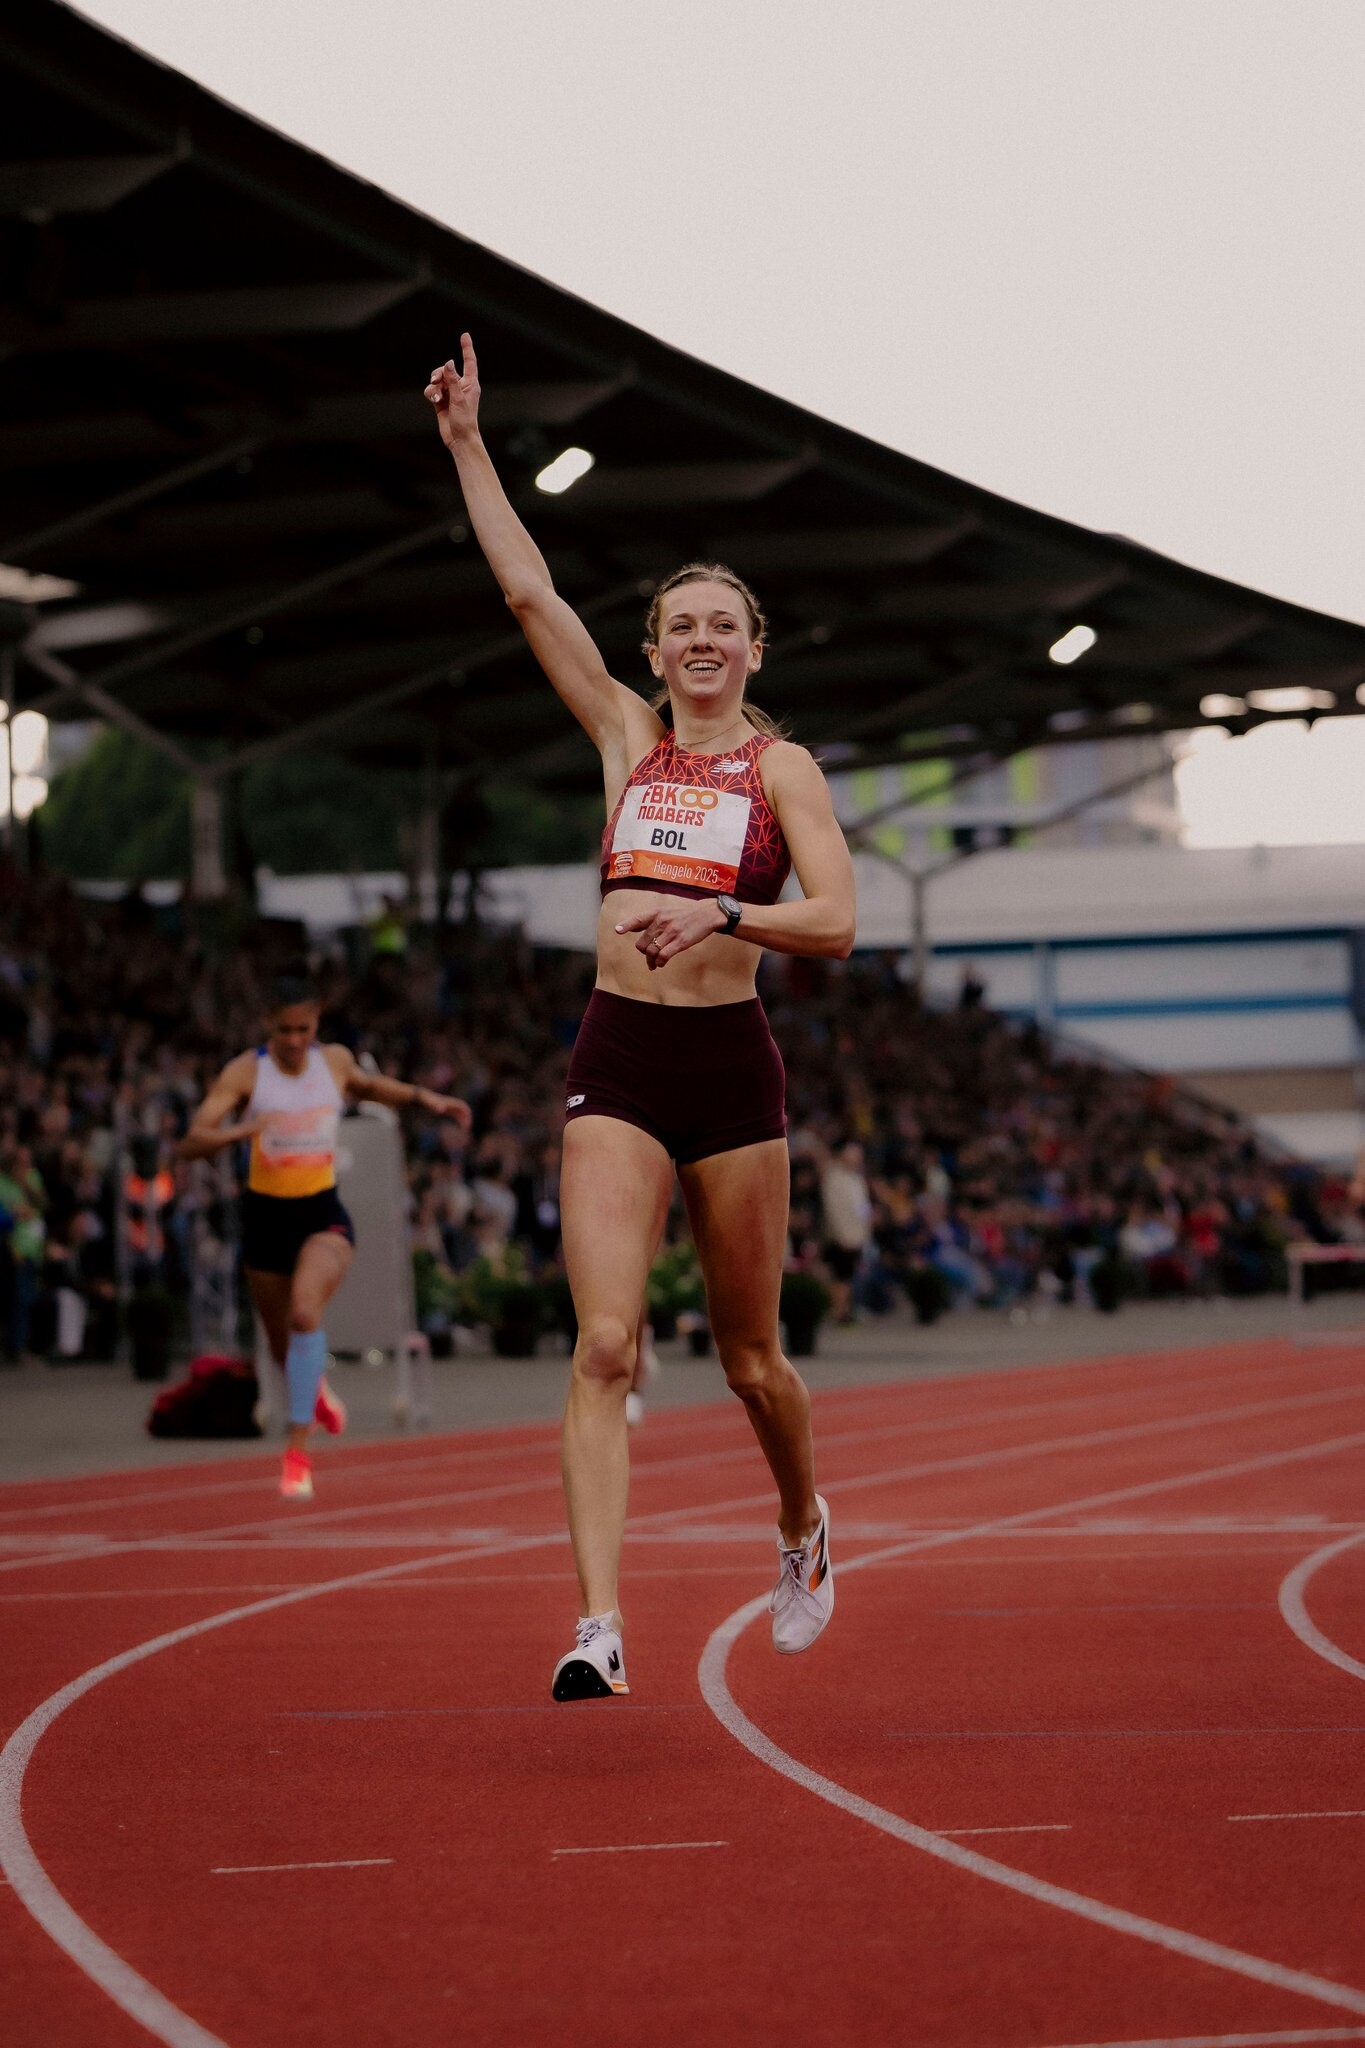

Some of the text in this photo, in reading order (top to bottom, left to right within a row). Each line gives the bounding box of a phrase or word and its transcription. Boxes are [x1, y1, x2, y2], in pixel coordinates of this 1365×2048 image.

[642, 784, 677, 805] FBK
[637, 805, 705, 826] NOABERS
[650, 828, 687, 850] BOL
[653, 859, 693, 879] Hengelo
[694, 866, 719, 884] 2025
